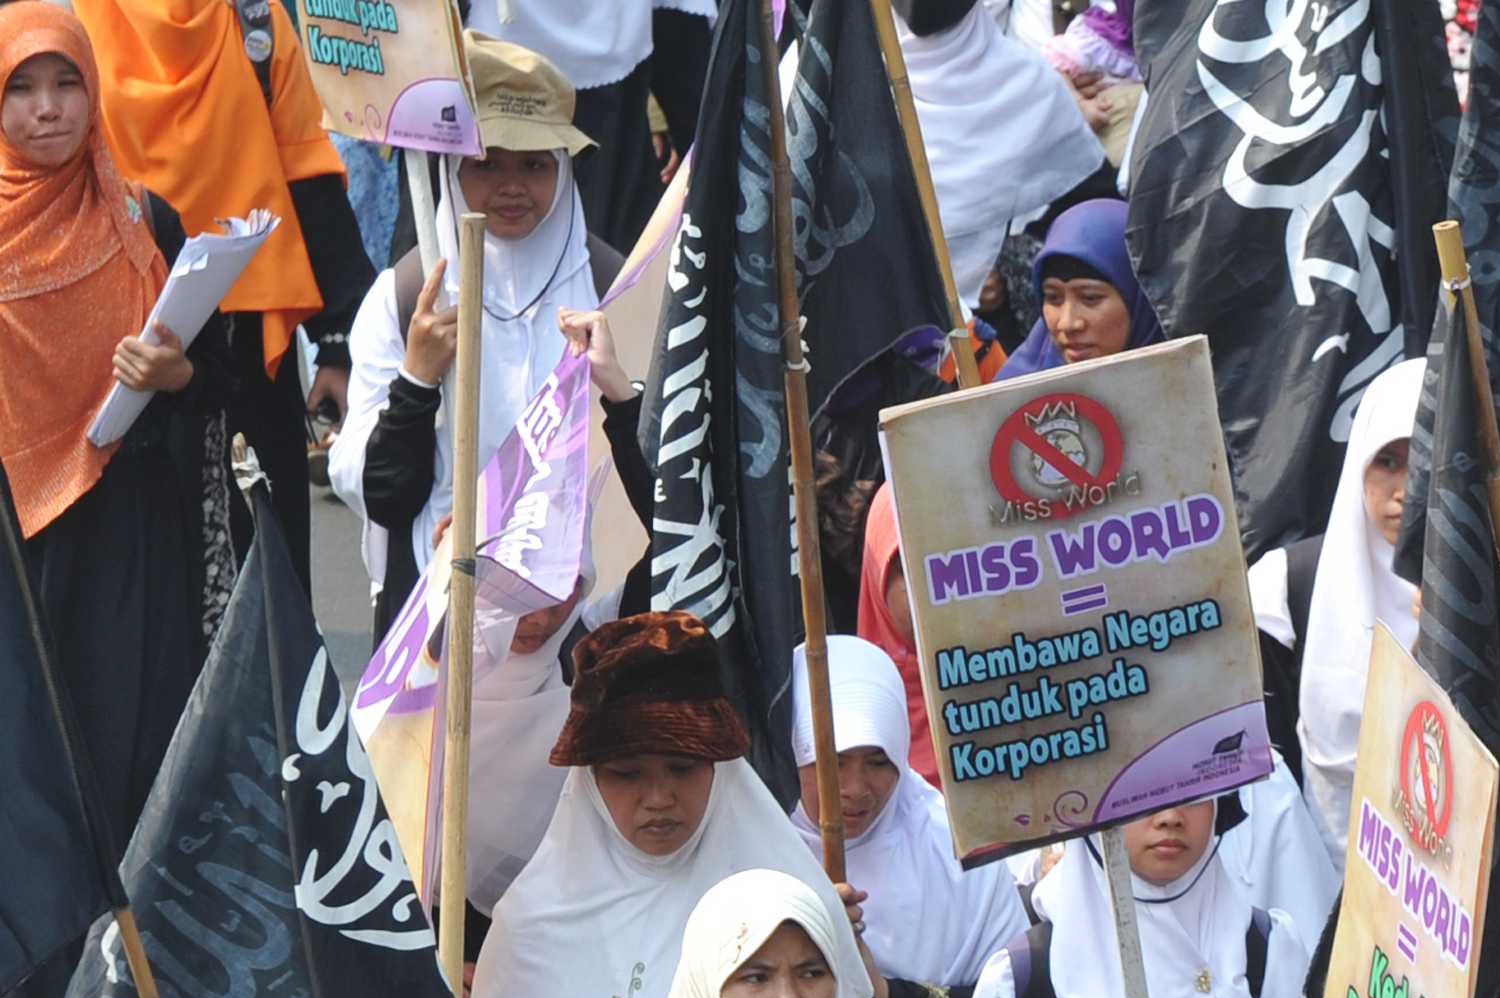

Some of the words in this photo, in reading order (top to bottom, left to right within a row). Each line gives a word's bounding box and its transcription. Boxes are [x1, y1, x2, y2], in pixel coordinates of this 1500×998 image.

[307, 24, 385, 76] Korporasi
[359, 0, 398, 36] pada
[927, 537, 1041, 602] MISS
[1048, 496, 1222, 576] WORLD
[937, 628, 1101, 690] Membawa
[1104, 599, 1222, 650] Negara
[944, 677, 1064, 735] tunduk
[1066, 659, 1148, 719] pada
[952, 714, 1108, 781] Korporasi
[1358, 799, 1403, 892] MISS
[1403, 852, 1471, 967] WORLD
